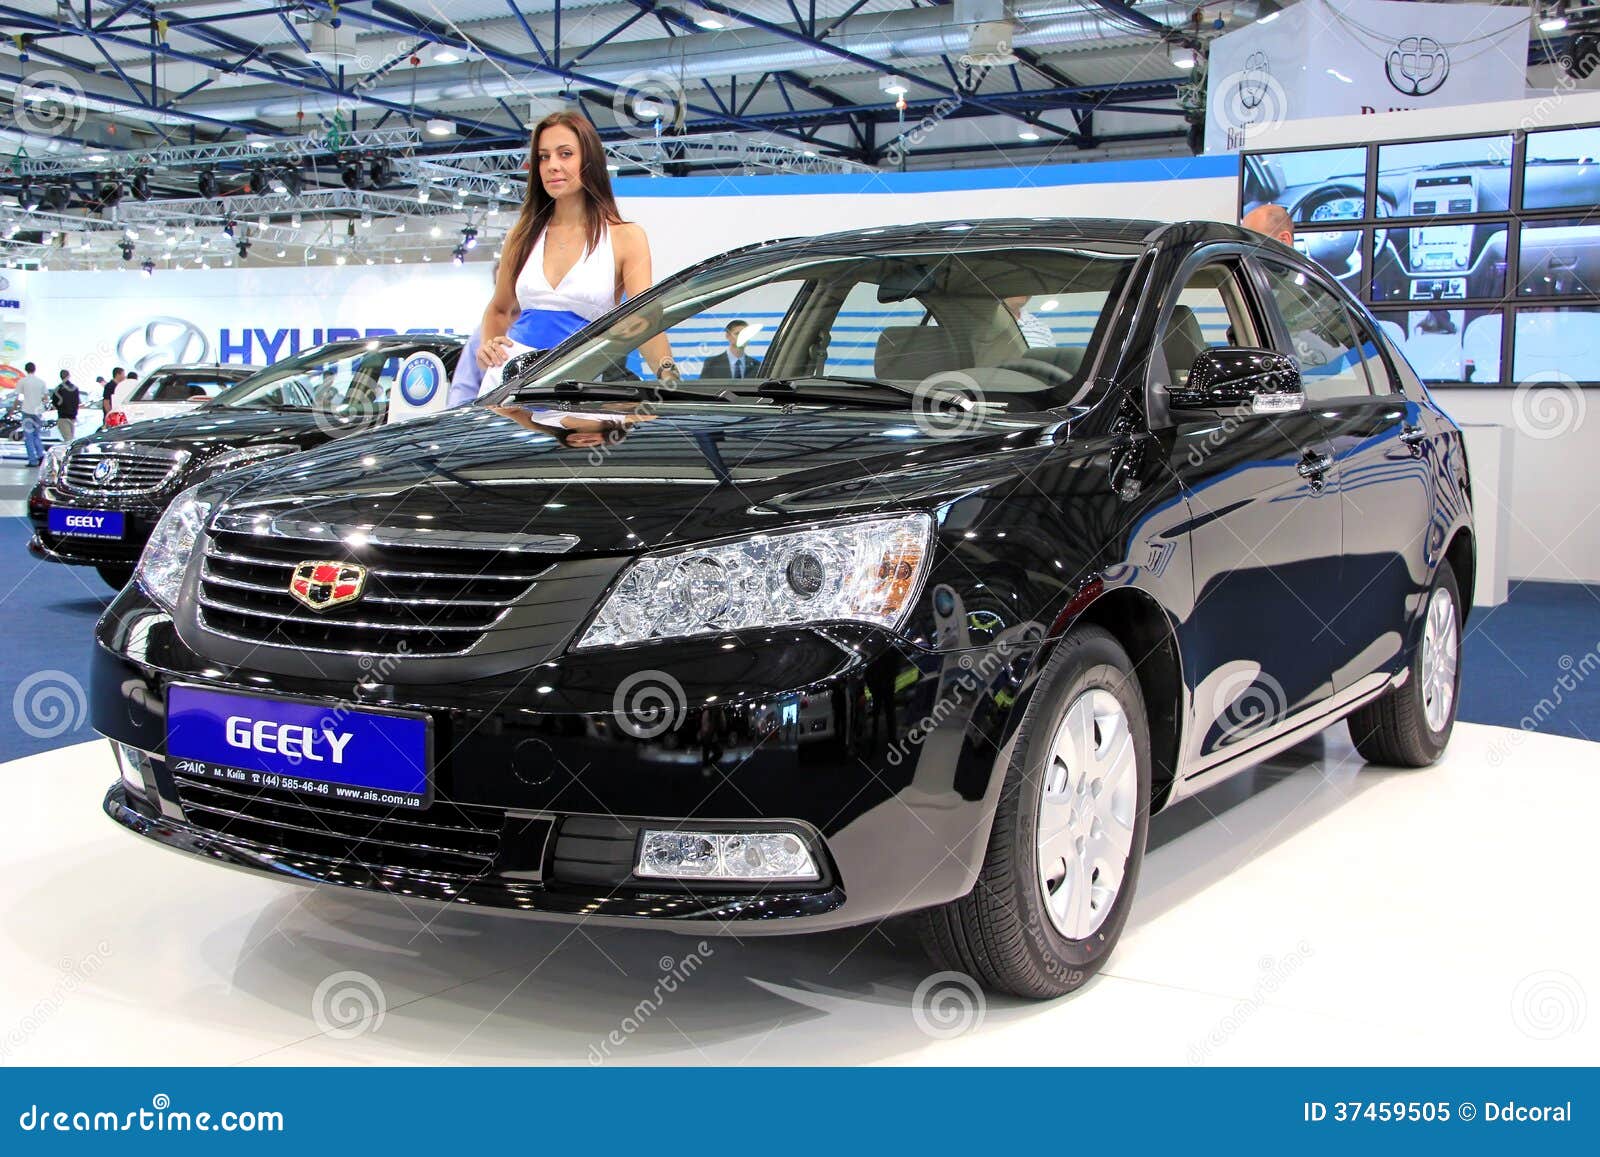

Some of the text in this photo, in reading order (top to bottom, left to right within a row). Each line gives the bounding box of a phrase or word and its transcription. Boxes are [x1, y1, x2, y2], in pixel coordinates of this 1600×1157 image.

[65, 515, 105, 528] GEELY
[225, 715, 354, 764] GEELY
[227, 768, 246, 781] Київ
[262, 774, 279, 788] (44)
[282, 777, 329, 794] 585-46-46
[336, 787, 420, 807] www.ais.com.ua
